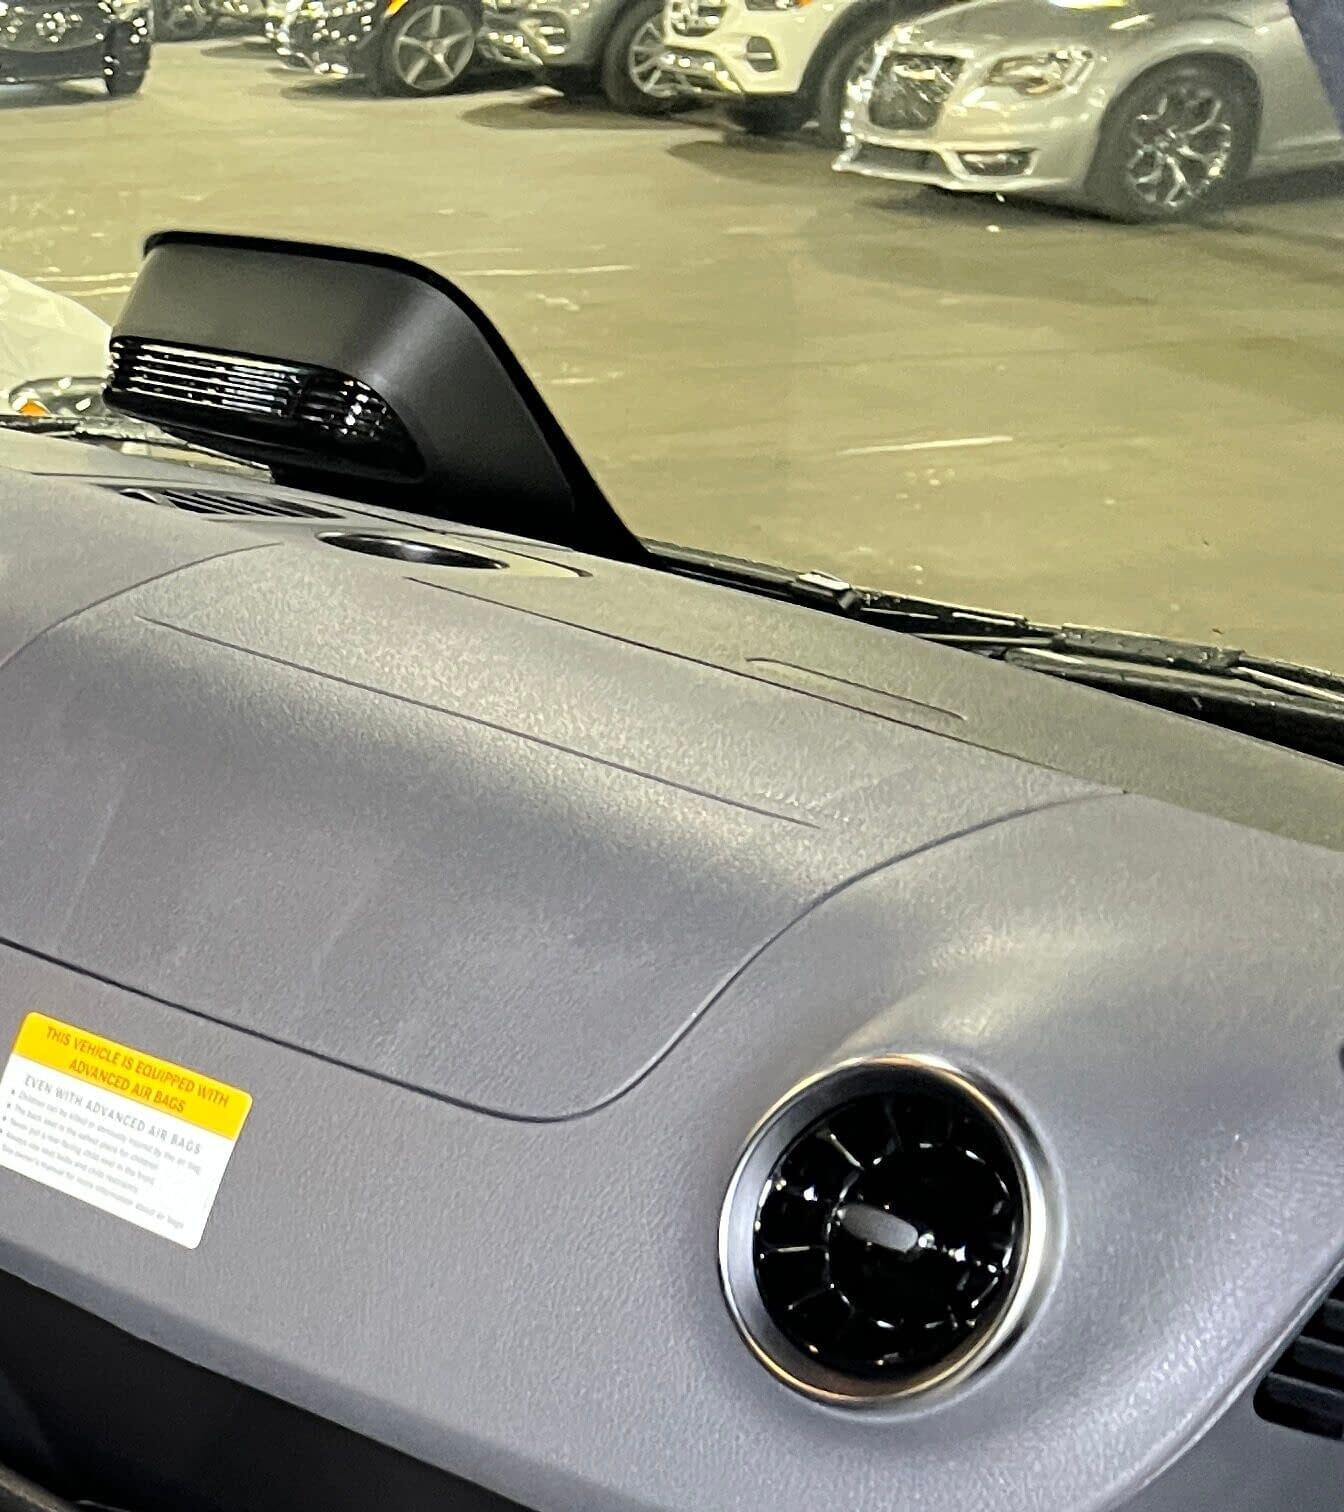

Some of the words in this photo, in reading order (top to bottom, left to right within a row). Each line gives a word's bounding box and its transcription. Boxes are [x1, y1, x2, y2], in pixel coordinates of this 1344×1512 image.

[46, 1025, 71, 1046] THIS
[73, 1038, 120, 1064] VEHICLE
[120, 1055, 134, 1070] IS
[134, 1060, 195, 1092] EQUIPPED
[196, 1084, 229, 1107] WITH
[68, 1058, 130, 1090] ADVANCED
[130, 1082, 152, 1101] AIR
[152, 1089, 186, 1113] BAGS
[23, 1073, 53, 1094] EVEN
[54, 1086, 83, 1106] WITH
[85, 1099, 145, 1131] ADVANCED
[147, 1124, 168, 1141] AIR
[169, 1132, 201, 1154] BAGS
